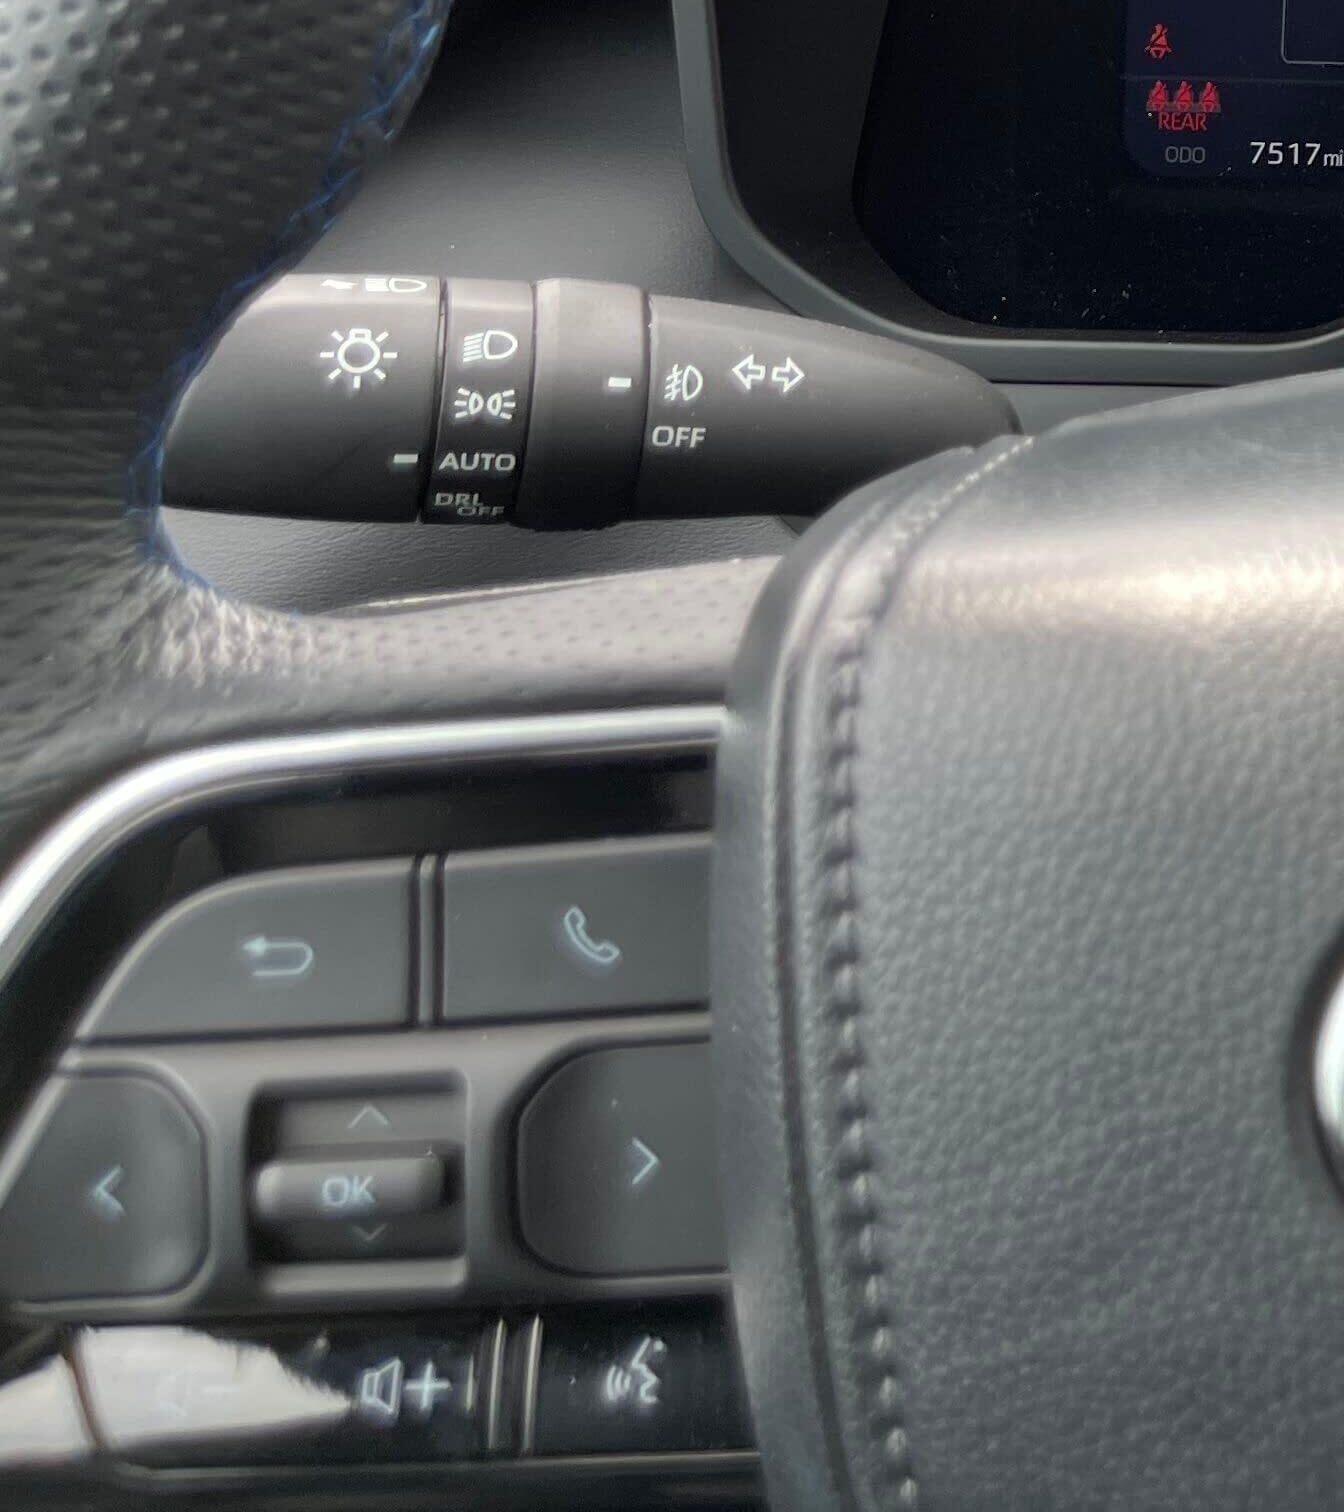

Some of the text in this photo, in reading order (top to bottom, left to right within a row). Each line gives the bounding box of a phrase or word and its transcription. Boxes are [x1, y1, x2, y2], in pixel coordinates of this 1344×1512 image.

[1158, 112, 1208, 131] REAR
[1164, 146, 1206, 163] ODO
[651, 426, 706, 448] OFF
[439, 452, 515, 472] AUTO
[434, 492, 484, 506] DRL
[456, 505, 505, 517] OFF
[321, 1174, 376, 1206] OK
